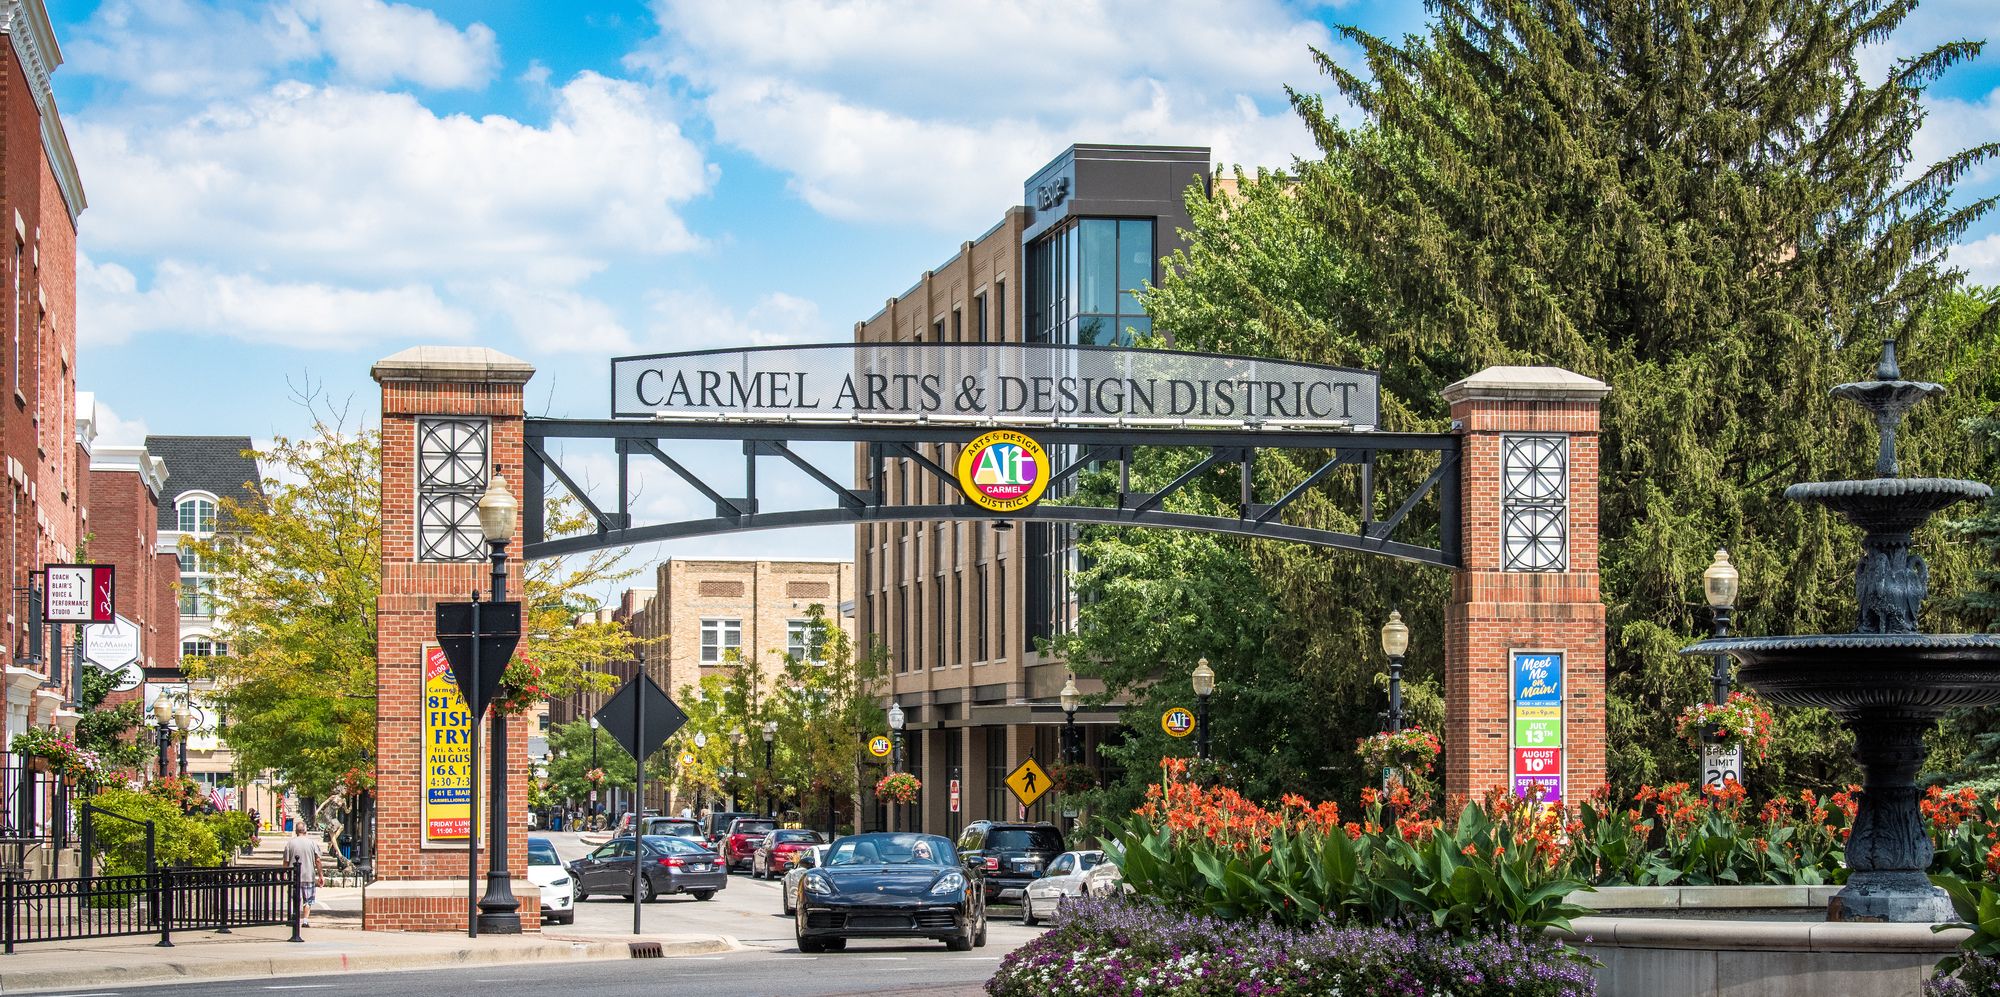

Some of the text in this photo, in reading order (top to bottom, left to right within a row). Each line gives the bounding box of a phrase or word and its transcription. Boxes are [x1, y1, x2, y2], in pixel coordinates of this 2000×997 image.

[636, 369, 1359, 419] CARMEL ARTS & DESIGN DISTRICT
[968, 433, 1040, 457] ARTS & DESIGN
[973, 445, 1035, 485] Art
[986, 486, 1024, 494] CARMEL
[979, 494, 1029, 509] DISTRICT
[430, 651, 444, 662] FRIDA
[433, 655, 446, 666] LUNC
[1521, 657, 1552, 671] Meet
[1529, 668, 1548, 680] Me
[1532, 679, 1544, 687] on
[1520, 682, 1558, 699] Main!
[430, 711, 471, 726] FISH
[435, 729, 471, 744] FRY
[430, 754, 470, 763] AUGUS
[431, 765, 446, 775] 16
[448, 765, 457, 775] &
[1706, 770, 1737, 788] 20
